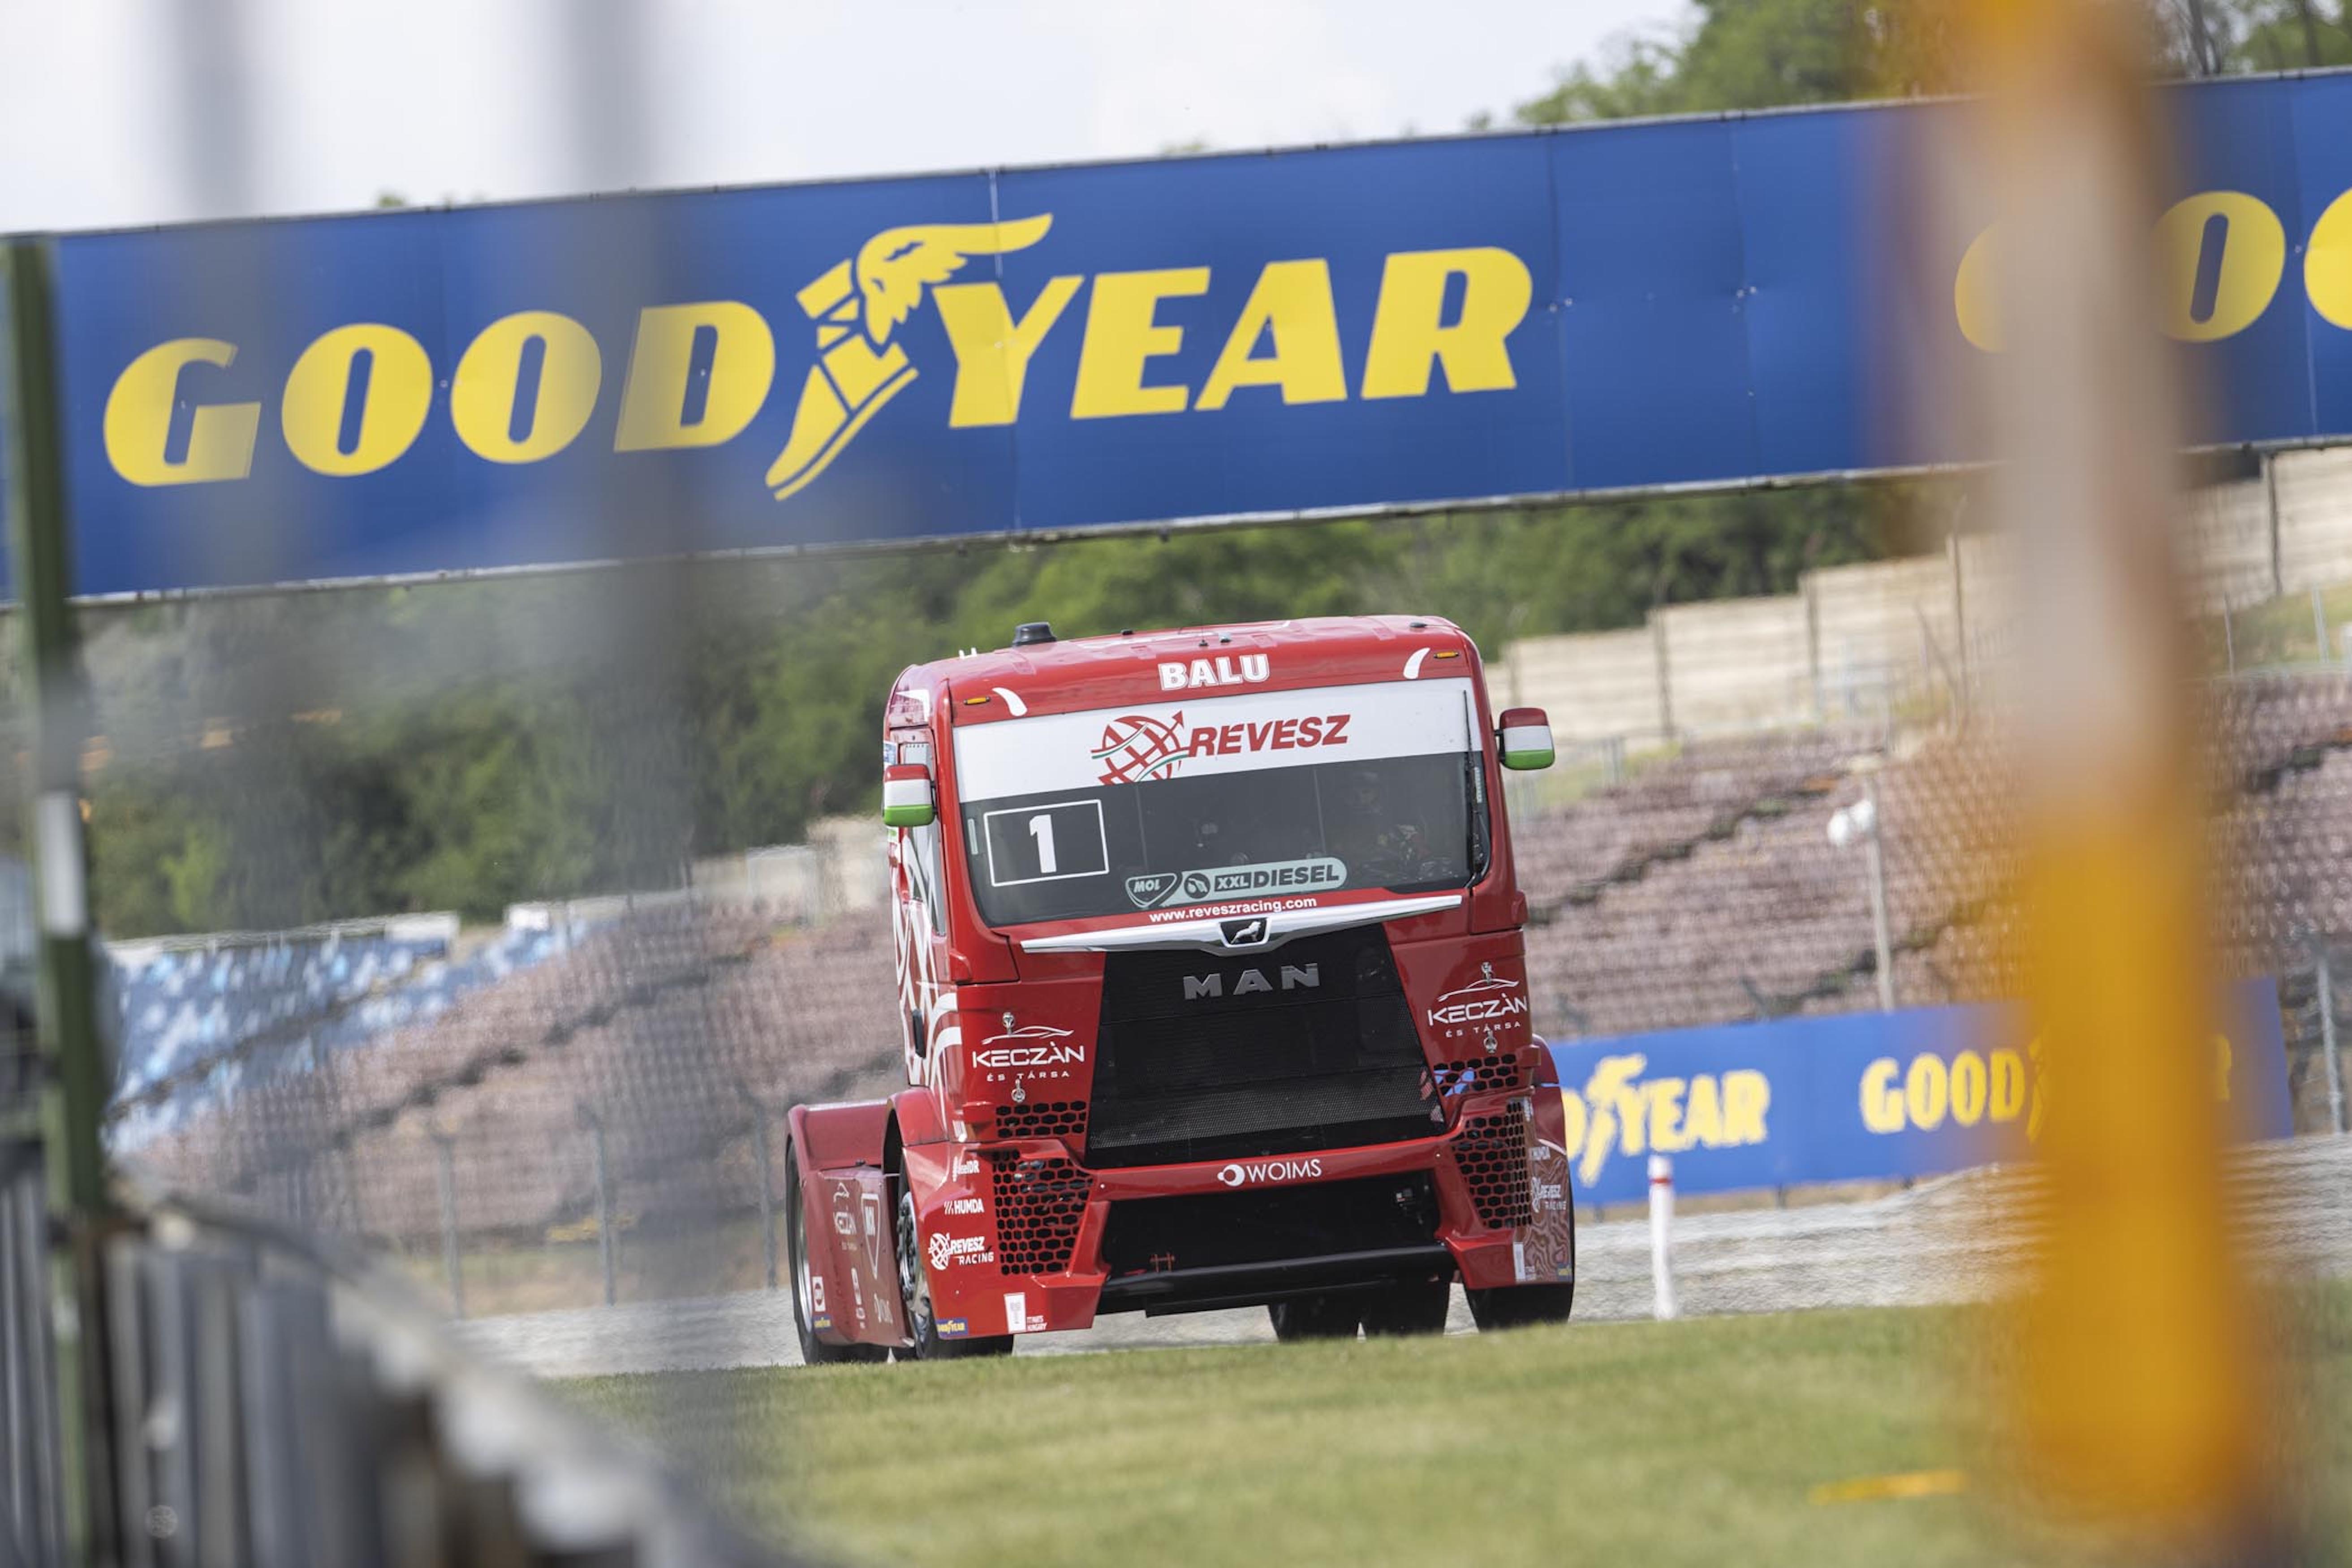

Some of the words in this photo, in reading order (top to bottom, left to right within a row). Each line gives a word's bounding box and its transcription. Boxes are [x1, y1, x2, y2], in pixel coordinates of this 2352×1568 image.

[104, 246, 1533, 487] GOODYEAR
[1158, 654, 1270, 690] BALU
[1188, 714, 1350, 757] REVESZ
[1029, 814, 1056, 873] 1
[1133, 879, 1160, 893] MOL
[1216, 875, 1249, 890] XXL
[1253, 865, 1340, 887] DIESEL
[1149, 896, 1317, 923] www.reveszracing.com
[1183, 963, 1320, 1000] MAN
[1246, 1159, 1322, 1183] WOIMS
[954, 1198, 984, 1215] HUMDA
[959, 1251, 994, 1265] RACING
